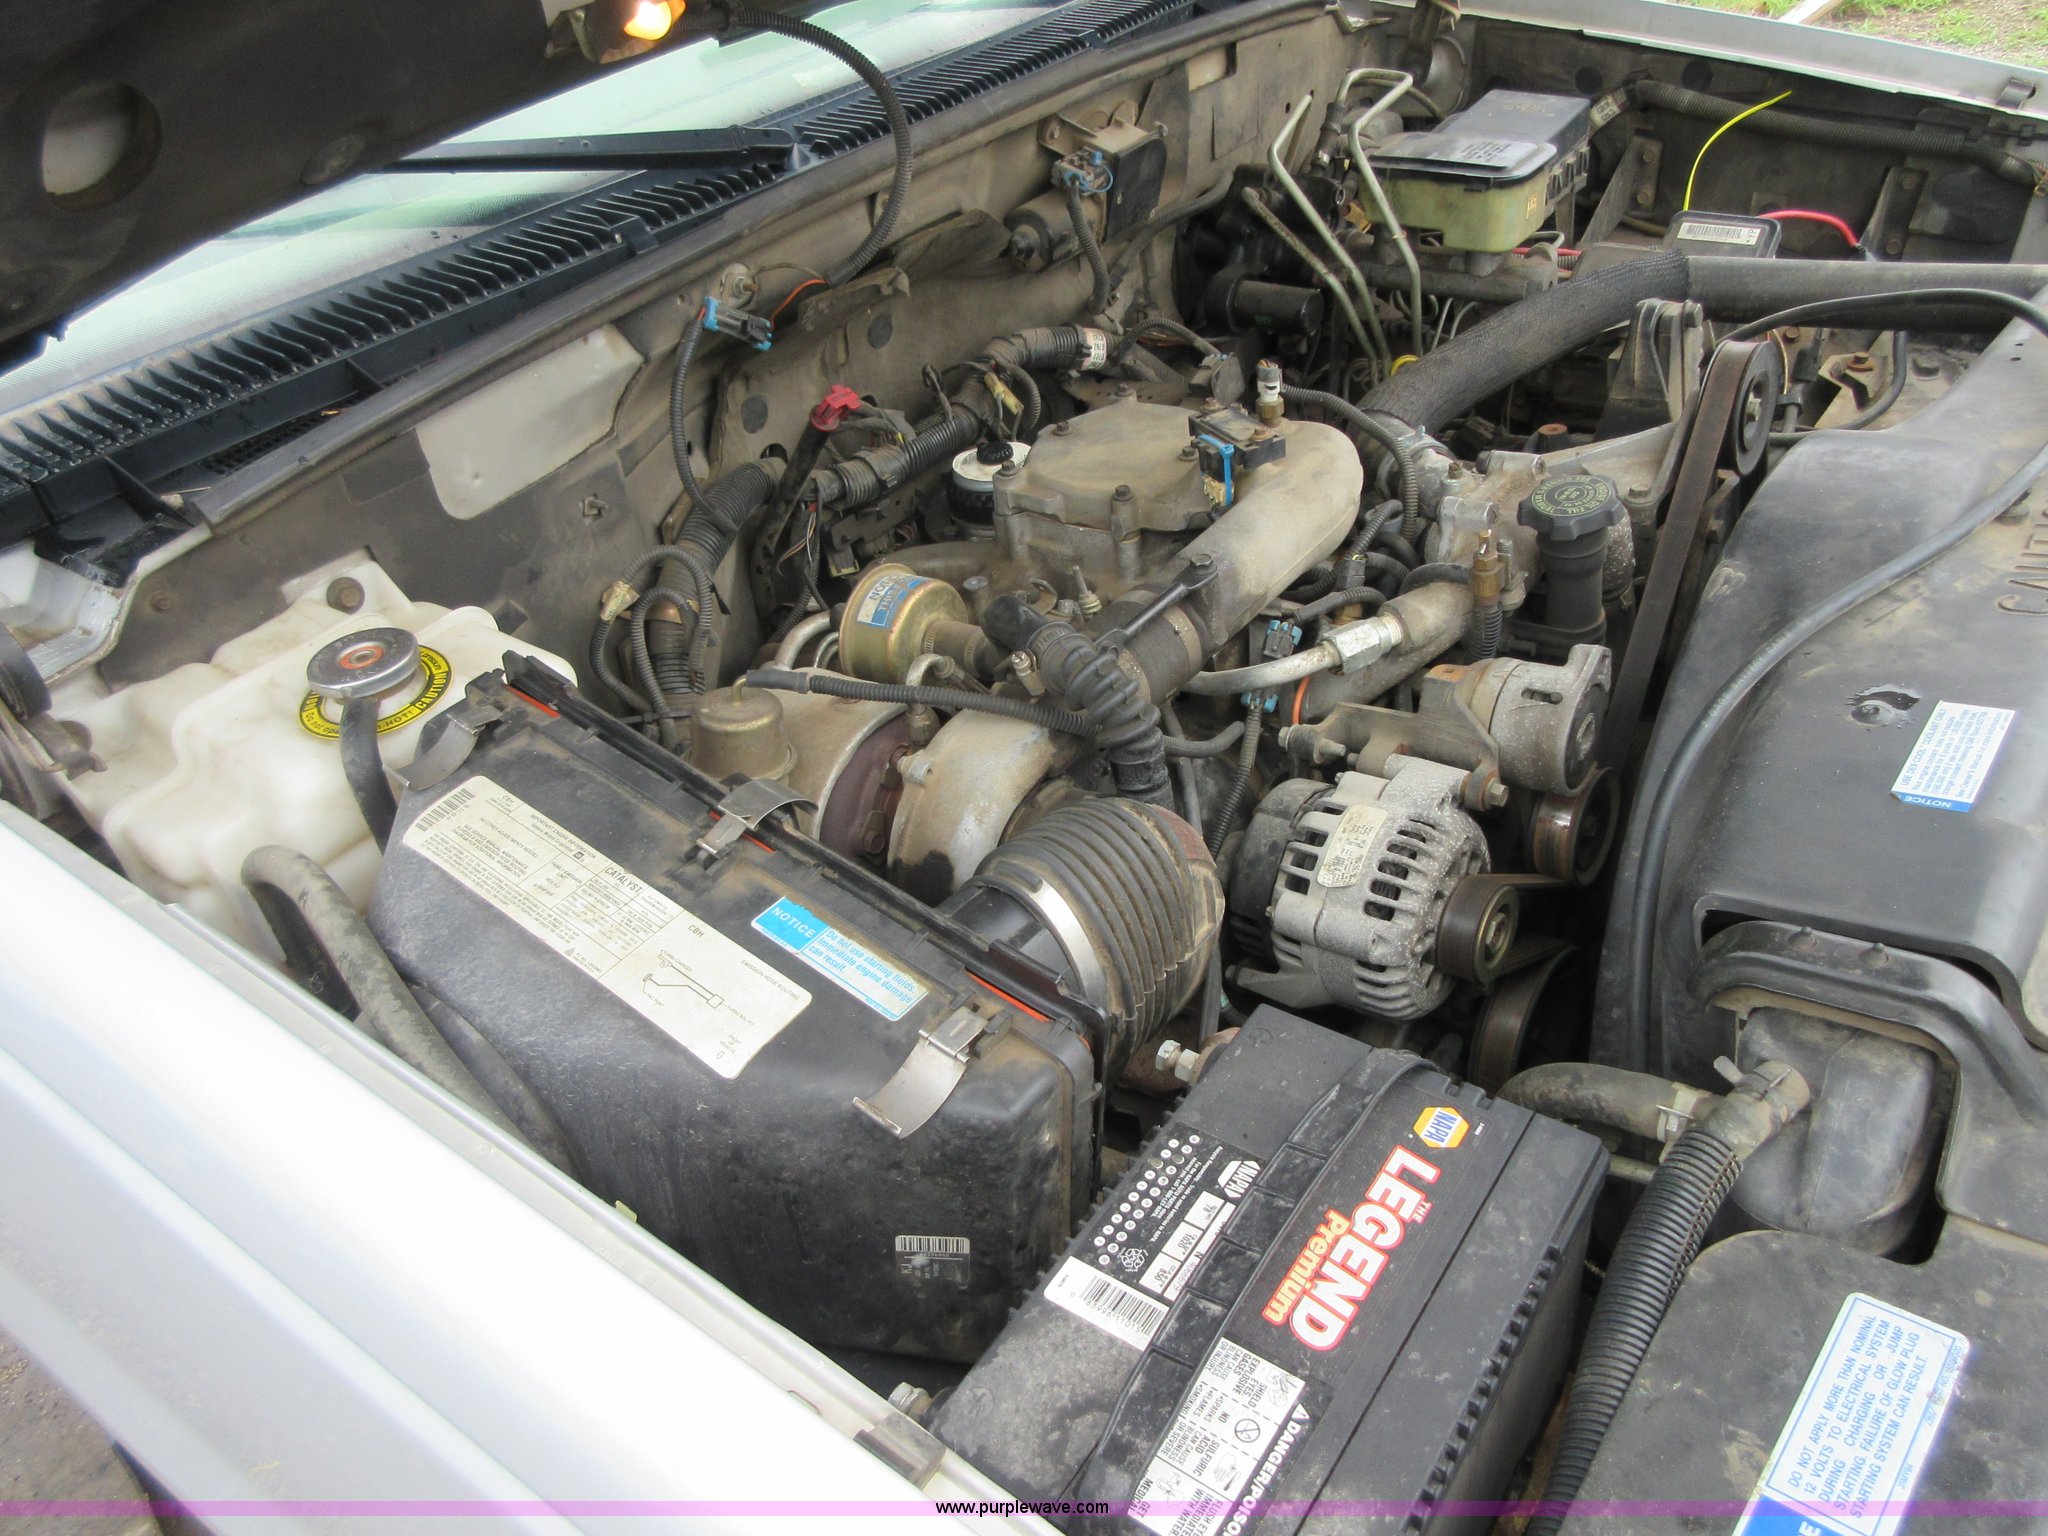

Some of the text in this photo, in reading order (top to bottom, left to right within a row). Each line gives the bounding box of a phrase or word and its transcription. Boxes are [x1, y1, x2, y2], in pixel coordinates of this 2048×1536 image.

[415, 671, 447, 710] CAUTION
[385, 710, 412, 727] HOT!
[1921, 722, 1940, 745] COOLANT
[1904, 796, 1952, 808] NOTICE
[603, 866, 644, 894] CATALYST
[687, 924, 705, 937] CBH
[771, 906, 816, 938] NOTICE
[807, 944, 847, 972] can result.
[817, 937, 913, 1004] Immediate engine damage
[825, 930, 918, 993] Do not use starting fluids.
[740, 959, 801, 1000] EMISSION HOSE ROUTING
[1424, 1111, 1457, 1143] NAPA
[1173, 1184, 1185, 1196] AUTO
[1225, 1163, 1258, 1195] NAPA
[1164, 1195, 1177, 1209] PARTS
[1412, 1201, 1433, 1224] THE
[1176, 1232, 1192, 1248] 1020
[1290, 1145, 1441, 1351] LEGEND
[1153, 1267, 1167, 1281] 850
[1262, 1209, 1351, 1325] Premium
[1207, 1341, 1228, 1372] OR INJURY
[1212, 1344, 1235, 1378] BLINDNESS
[1220, 1348, 1243, 1381] CAN CAUSE
[1234, 1353, 1251, 1376] GASES
[1234, 1357, 1260, 1395] EXPLOSIVE
[1242, 1378, 1259, 1399] EYES.
[1248, 1382, 1267, 1408] SHIELD
[1788, 1315, 1877, 1488] DO NOT APPLY MORE THAN NOMINAL
[1804, 1484, 1816, 1495] 12
[1811, 1446, 1834, 1479] VOLTS
[1828, 1426, 1843, 1442] TO
[1837, 1363, 1872, 1422] ELECTRICAL
[1867, 1321, 1891, 1359] SYSTEM
[1176, 1421, 1185, 1431] OR
[1219, 1411, 1230, 1423] NO
[1819, 1328, 1906, 1503] DURING CHARGING OR JUMP
[1834, 1334, 1921, 1511] STARTING. FAILURE OF GLOW PLUG
[1162, 1431, 1180, 1456] SEVERE
[1169, 1425, 1194, 1461] BLINDNESS
[1177, 1430, 1201, 1466] CAN CAUSE
[1196, 1435, 1211, 1454] ACID
[1850, 1356, 1929, 1518] STARTING SYSTEM CAN RESULT.
[1193, 1440, 1220, 1477] SULFURIC
[1127, 1477, 1153, 1513] MEDICAL
[1137, 1501, 1150, 1518] GET
[1187, 1487, 1204, 1509] WITH
[1203, 1499, 1222, 1524] FLUSH
